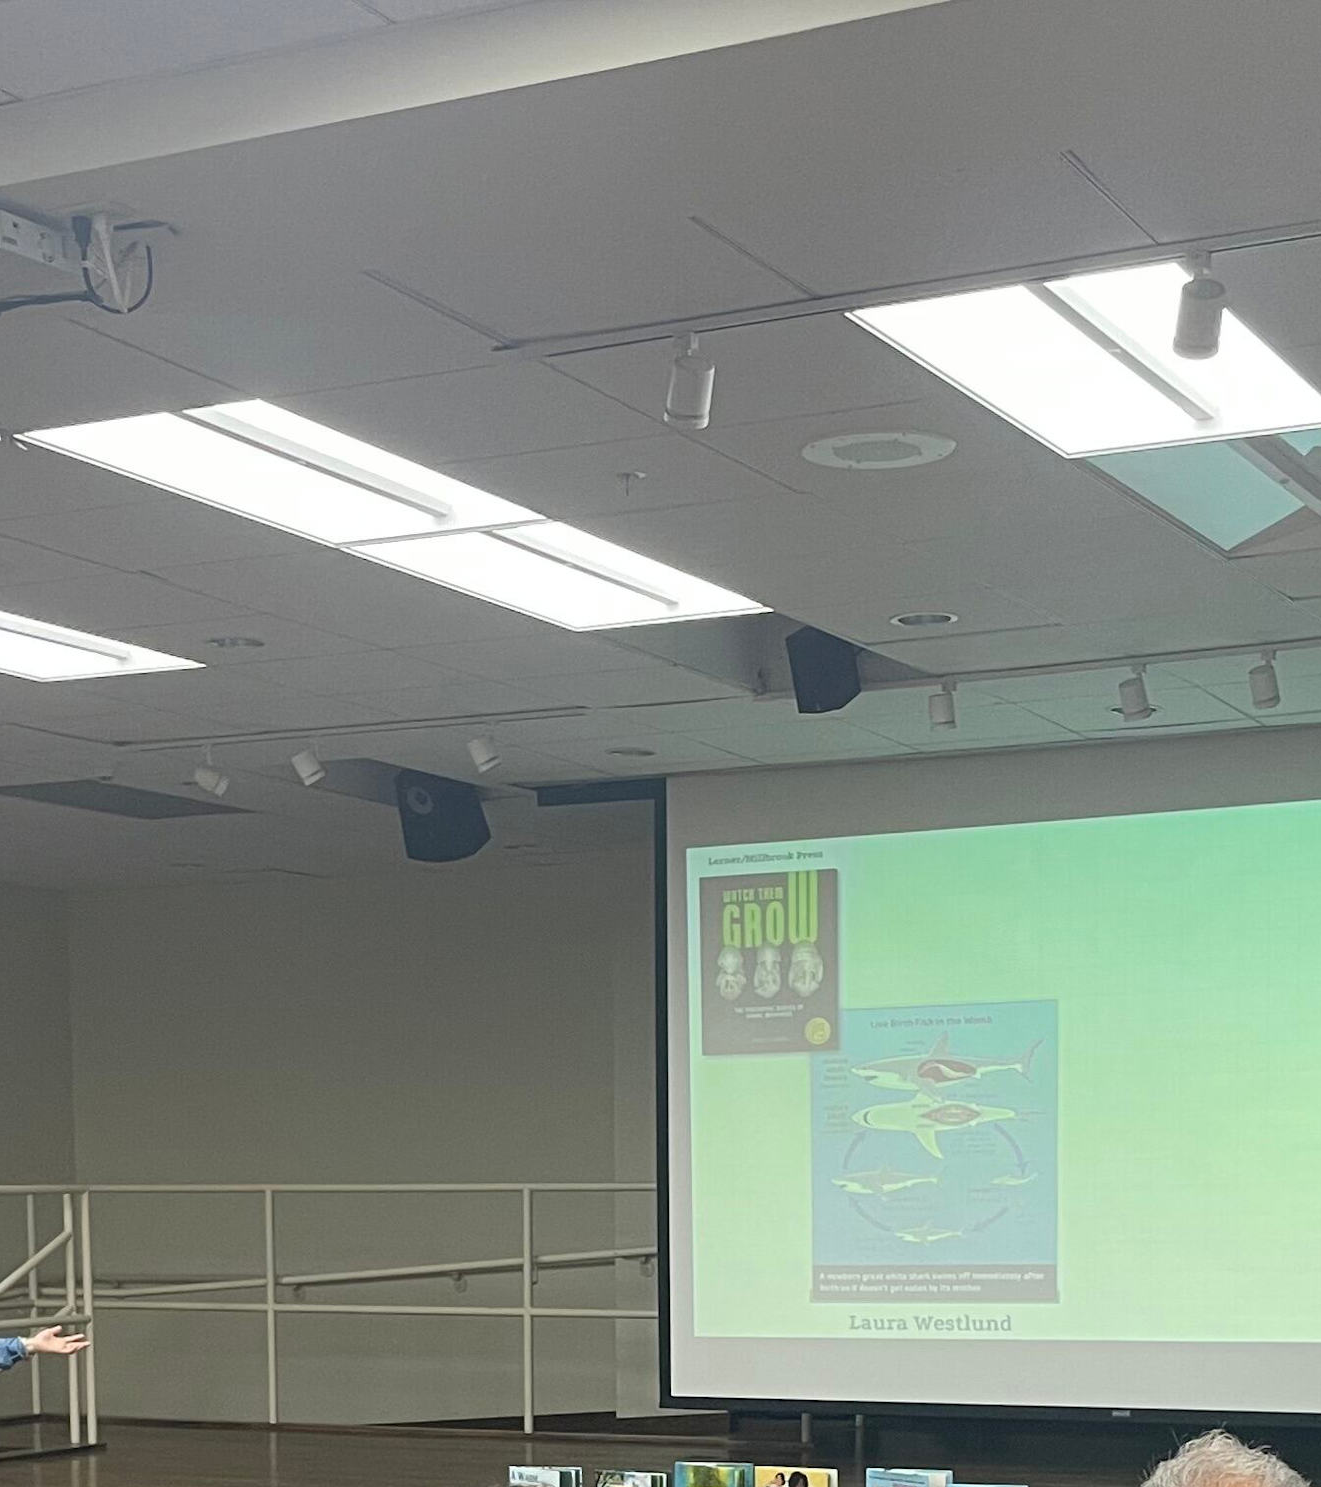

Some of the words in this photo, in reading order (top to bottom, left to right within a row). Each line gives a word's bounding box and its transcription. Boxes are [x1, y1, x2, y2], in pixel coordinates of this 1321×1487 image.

[722, 889, 755, 903] WATCH
[757, 887, 784, 901] THEM
[722, 870, 818, 949] GROW
[849, 1314, 909, 1331] Laura
[912, 1313, 1012, 1332] Westlund
